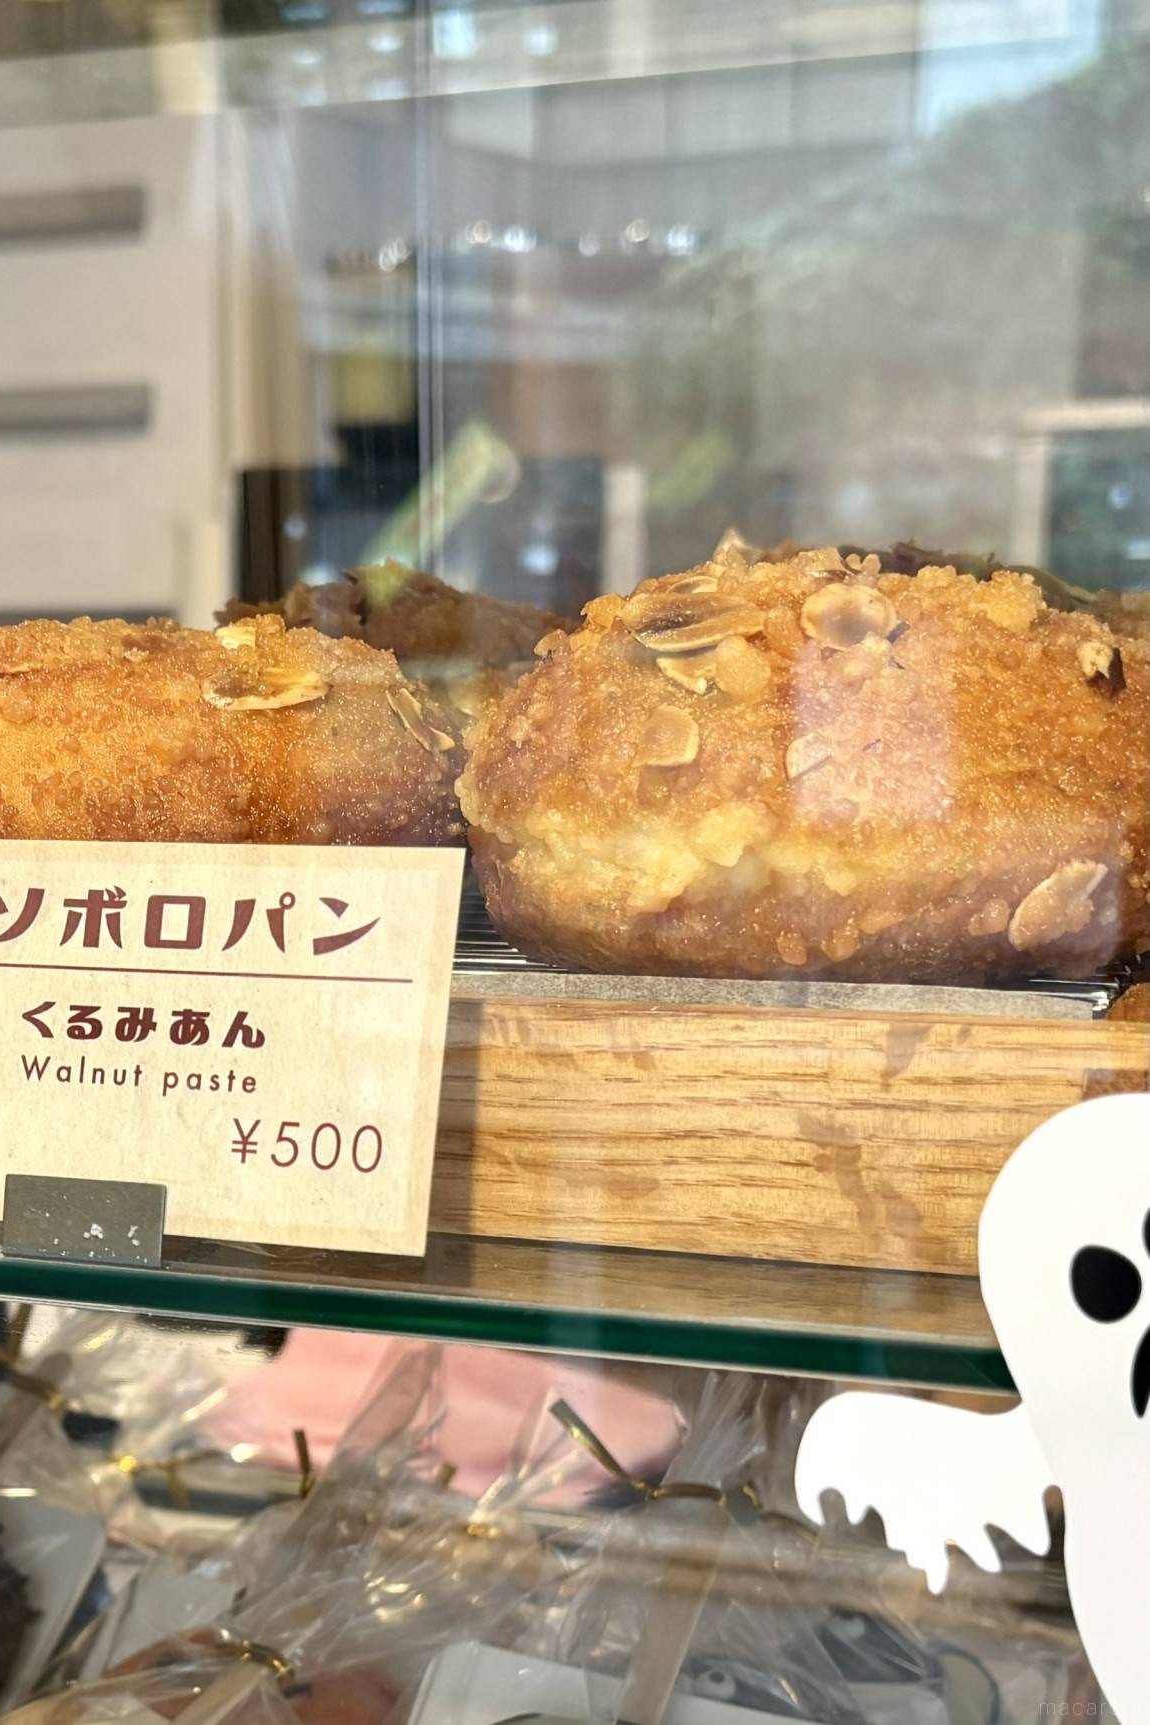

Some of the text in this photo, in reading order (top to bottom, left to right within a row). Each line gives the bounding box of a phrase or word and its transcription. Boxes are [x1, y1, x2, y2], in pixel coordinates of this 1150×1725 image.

[21, 1001, 266, 1050] くるみあん
[21, 1055, 258, 1097] Walnut paste
[231, 1118, 383, 1174] ¥500
